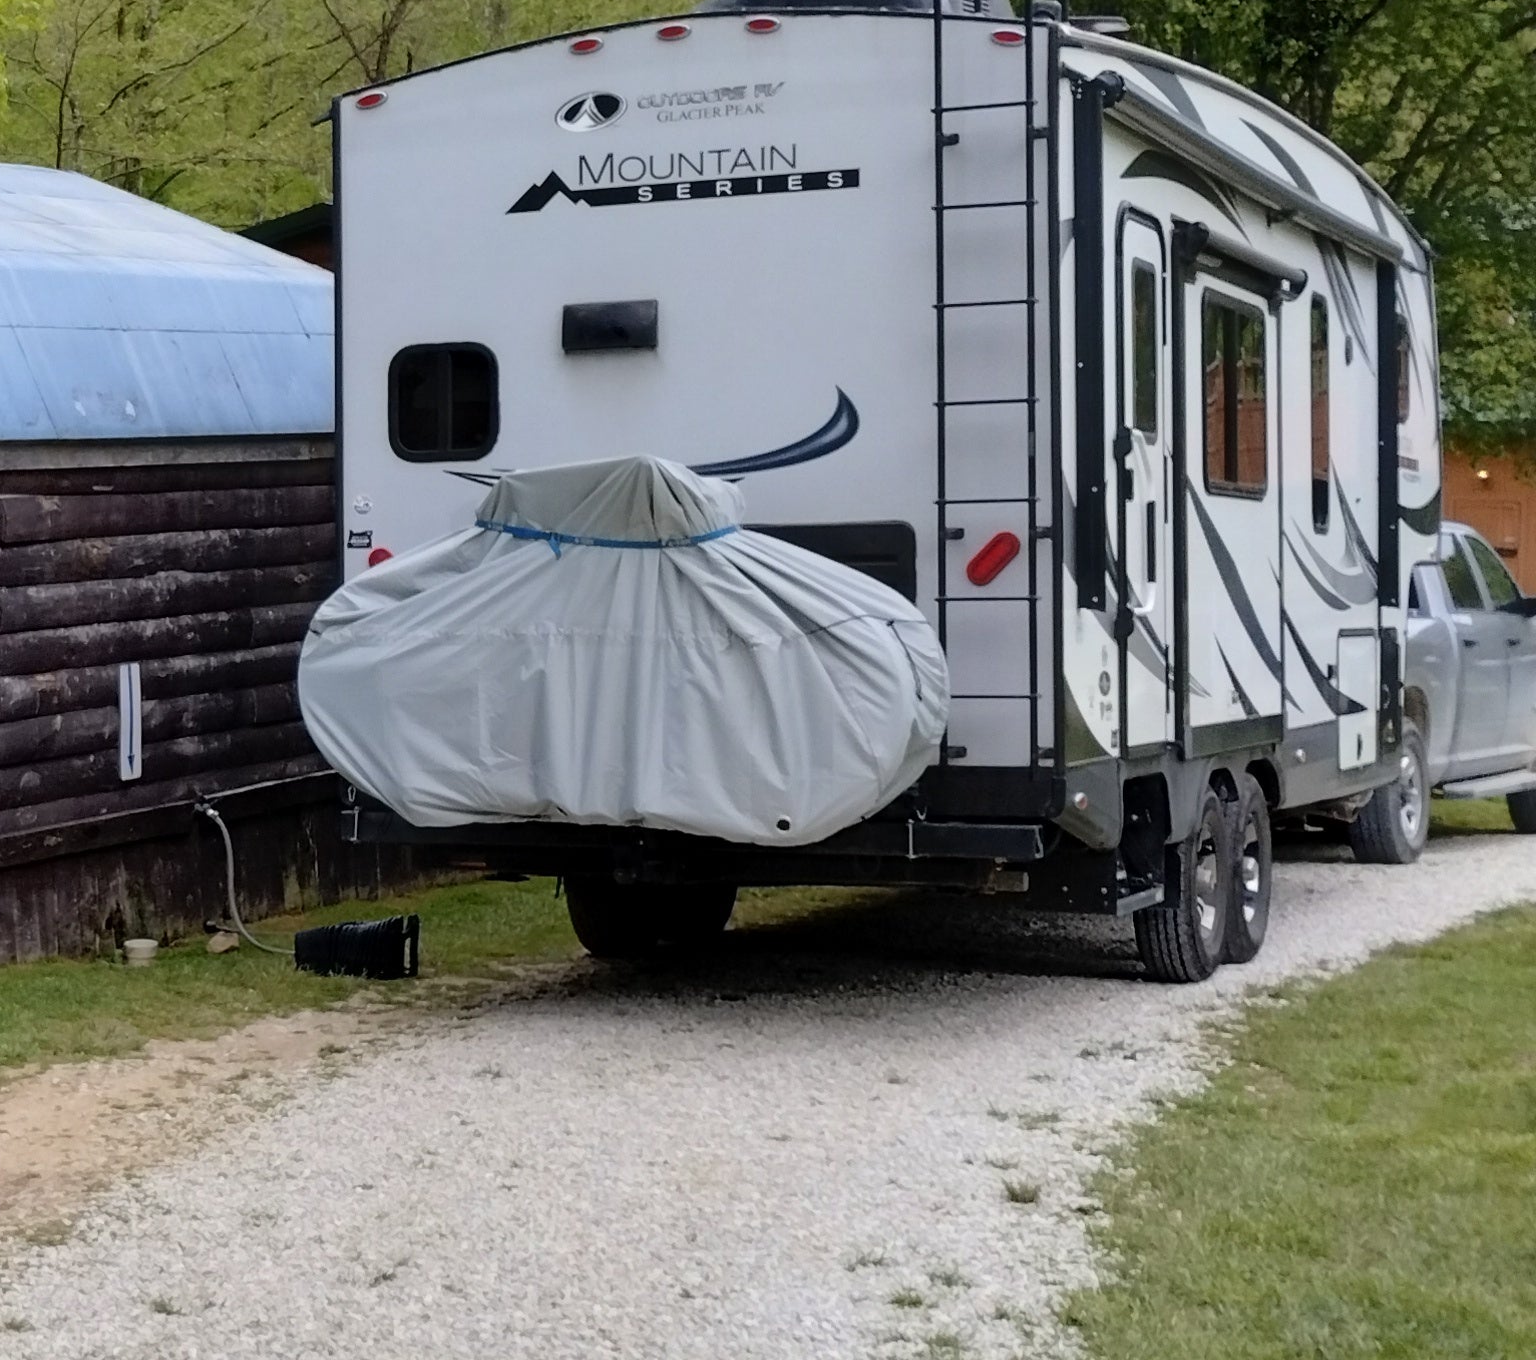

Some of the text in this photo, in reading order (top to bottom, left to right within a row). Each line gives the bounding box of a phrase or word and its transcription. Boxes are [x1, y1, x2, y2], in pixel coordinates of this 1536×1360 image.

[657, 103, 765, 122] GLACIER PEAK
[578, 143, 797, 186] MOUNTAIN
[637, 171, 844, 202] SERIES
